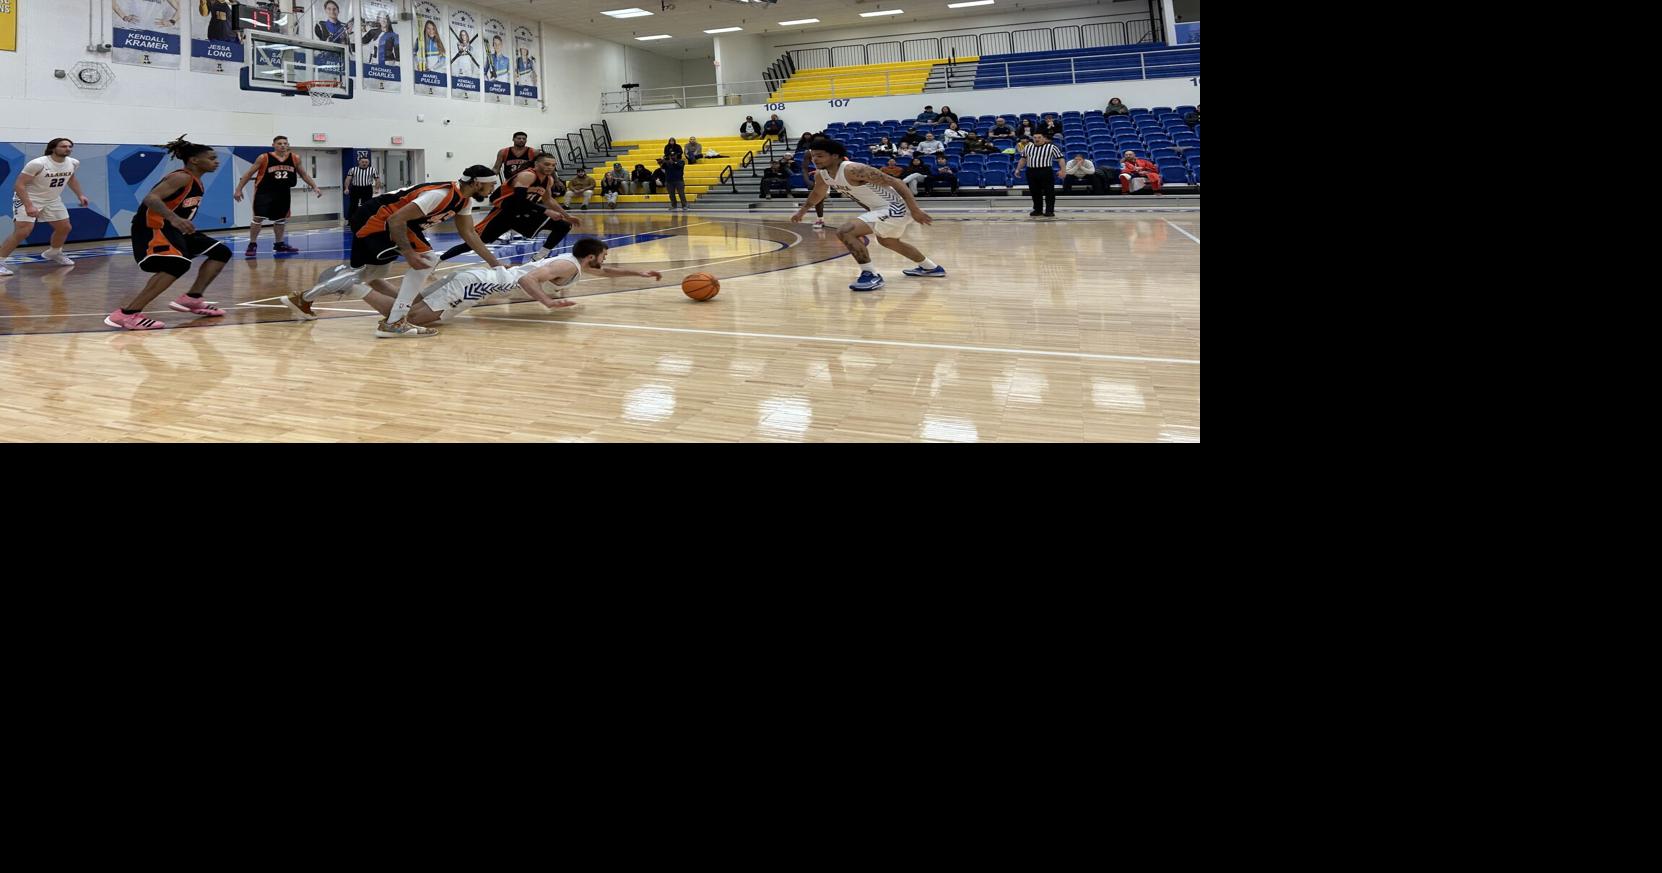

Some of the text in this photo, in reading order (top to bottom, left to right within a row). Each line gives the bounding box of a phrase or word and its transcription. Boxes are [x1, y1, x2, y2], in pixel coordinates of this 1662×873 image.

[128, 33, 166, 43] KENDALL
[125, 39, 169, 50] KRAMER
[207, 44, 231, 52] JESSA
[207, 50, 232, 58] LONG
[368, 71, 396, 79] CHARLES
[764, 102, 786, 112] 108
[828, 98, 850, 108] 107
[274, 170, 289, 180] 32
[49, 177, 65, 188] 22
